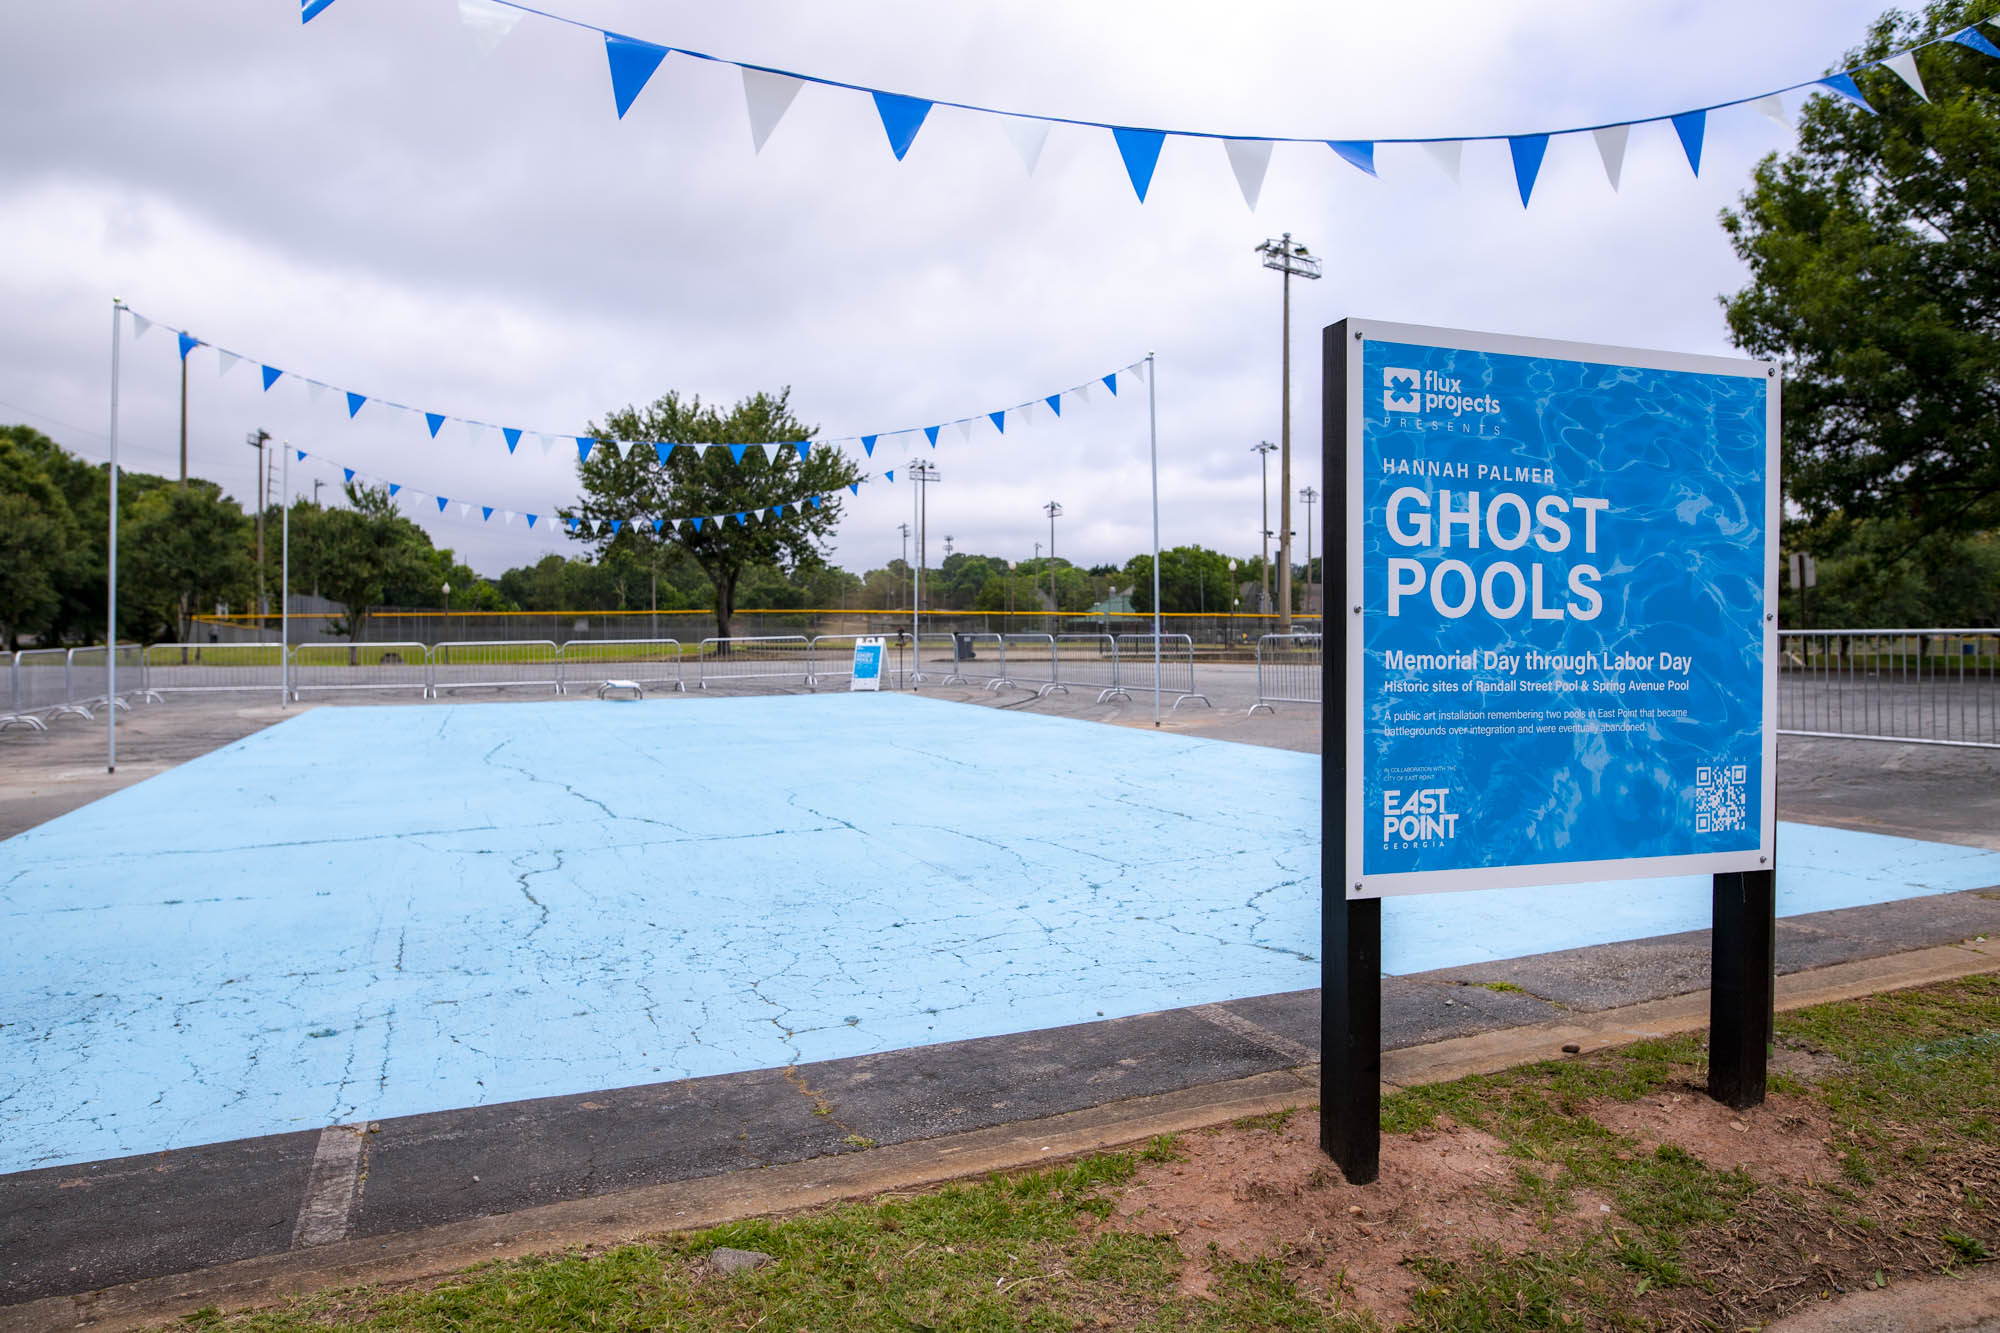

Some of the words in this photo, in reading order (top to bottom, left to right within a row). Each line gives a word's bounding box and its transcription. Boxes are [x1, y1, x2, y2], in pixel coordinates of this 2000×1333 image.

[1424, 370, 1461, 393] flux
[1425, 393, 1500, 416] projects
[1384, 417, 1500, 436] PRESENTS
[1383, 457, 1469, 479] HANNAH
[1478, 464, 1555, 484] PALMER
[1386, 486, 1609, 553] GHOST
[1388, 558, 1602, 621] POOLS
[1385, 650, 1477, 670] Memorial
[1484, 651, 1520, 675] Day
[1525, 650, 1597, 675] through
[1603, 651, 1654, 670] Labor
[1659, 652, 1692, 675] Day
[1384, 680, 1429, 693] Historic
[1432, 680, 1459, 692] sites
[1462, 680, 1473, 692] of
[1476, 680, 1516, 692] Randall
[1519, 680, 1552, 692] Street
[1555, 680, 1578, 692] Pool
[1581, 681, 1589, 692] &
[1592, 680, 1626, 693] Spring
[1628, 680, 1665, 691] Avenue
[1668, 680, 1689, 691] Pool
[1384, 711, 1391, 721] A
[1393, 711, 1421, 723] public
[1423, 712, 1436, 721] art
[1438, 710, 1485, 721] installation
[1487, 709, 1543, 721] remembering
[1546, 710, 1562, 719] two
[1564, 709, 1585, 720] pools
[1588, 709, 1596, 719] in
[1598, 709, 1615, 718] East
[1618, 709, 1638, 718] Point
[1640, 708, 1655, 718] that
[1657, 708, 1688, 717] became
[1384, 725, 1446, 738] battlegrounds
[1448, 727, 1467, 735] over
[1470, 725, 1515, 736] integration
[1518, 724, 1534, 734] and
[1536, 725, 1556, 733] were
[1558, 724, 1598, 734] eventually
[1600, 722, 1647, 732] abandoned.
[1384, 788, 1449, 815] EAST
[1384, 814, 1459, 842] POINT
[1384, 841, 1445, 850] GEORGIA
